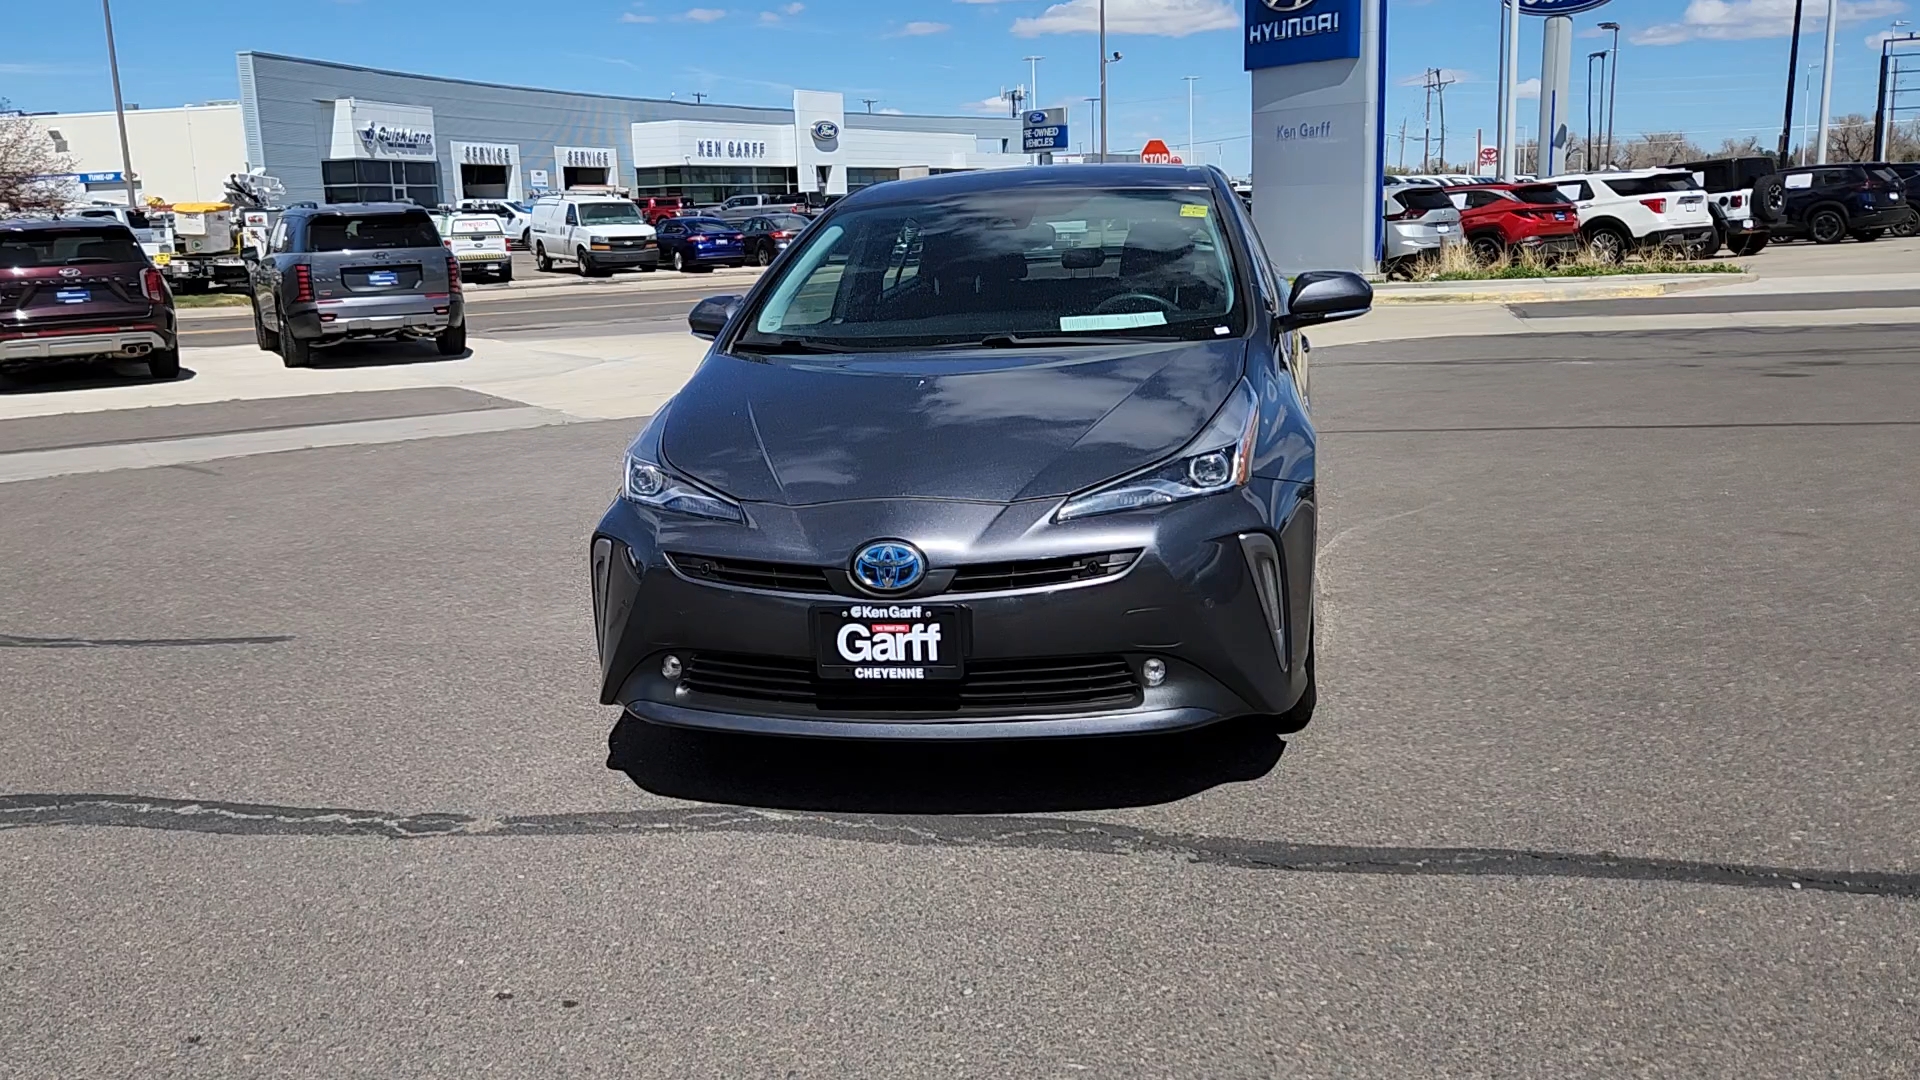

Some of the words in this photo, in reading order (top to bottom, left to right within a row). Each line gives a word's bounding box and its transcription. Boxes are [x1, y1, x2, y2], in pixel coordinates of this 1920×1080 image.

[1249, 12, 1339, 44] HYUNDAI
[820, 124, 836, 137] Ford
[1276, 125, 1296, 139] Ken
[1299, 121, 1331, 140] Garff
[698, 140, 721, 152] KEN
[728, 141, 765, 153] GARFF
[1025, 137, 1055, 148] VEHICLES
[465, 146, 509, 158] SERVICE
[567, 150, 608, 161] SERVICE
[1143, 153, 1169, 164] STOP
[87, 173, 116, 181] TUNE-UP
[862, 606, 889, 618] Ken
[889, 606, 922, 618] Garff
[836, 623, 941, 662] Garff
[855, 667, 925, 679] CHEYENNE
